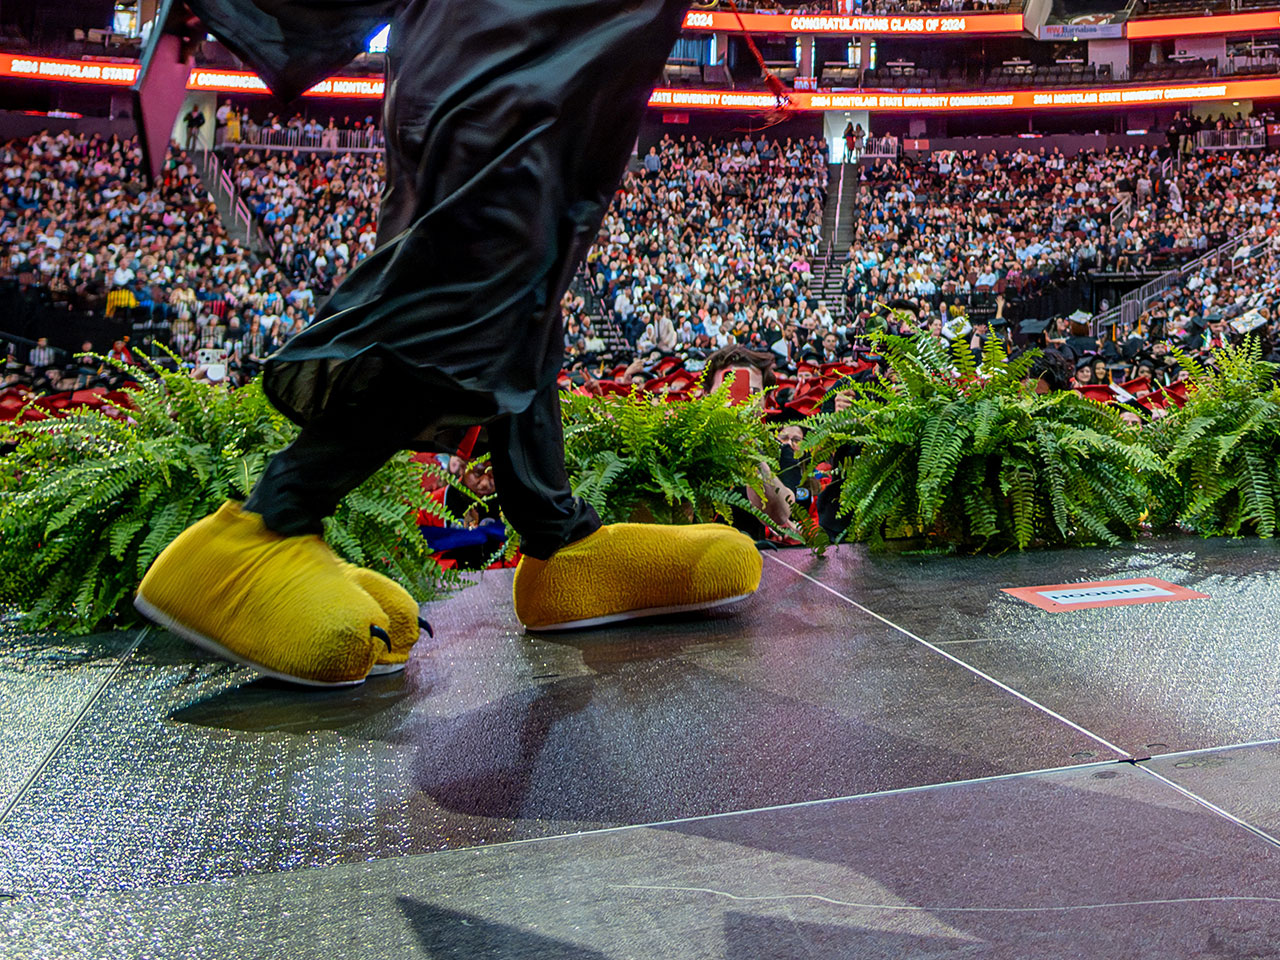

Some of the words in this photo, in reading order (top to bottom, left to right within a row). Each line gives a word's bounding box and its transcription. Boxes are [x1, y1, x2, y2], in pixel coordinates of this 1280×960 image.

[686, 13, 714, 27] 2024
[791, 17, 889, 30] CONGRATULATIONS
[890, 18, 924, 31] CLASS
[925, 18, 940, 31] OF
[940, 18, 966, 31] 2024
[11, 59, 38, 73] 2024
[39, 62, 101, 80] MONTCLAIR
[101, 67, 135, 81] STATE
[673, 93, 720, 105] UNIVERSITY
[832, 96, 877, 107] MONTCLAIR
[879, 96, 903, 107] STATE
[904, 96, 948, 107] UNIVERSITY
[1053, 93, 1098, 104] MONTCLAIR
[1098, 92, 1121, 103] STATE
[1122, 89, 1163, 102] UNIVERSITY
[1051, 586, 1156, 600] HOODING
